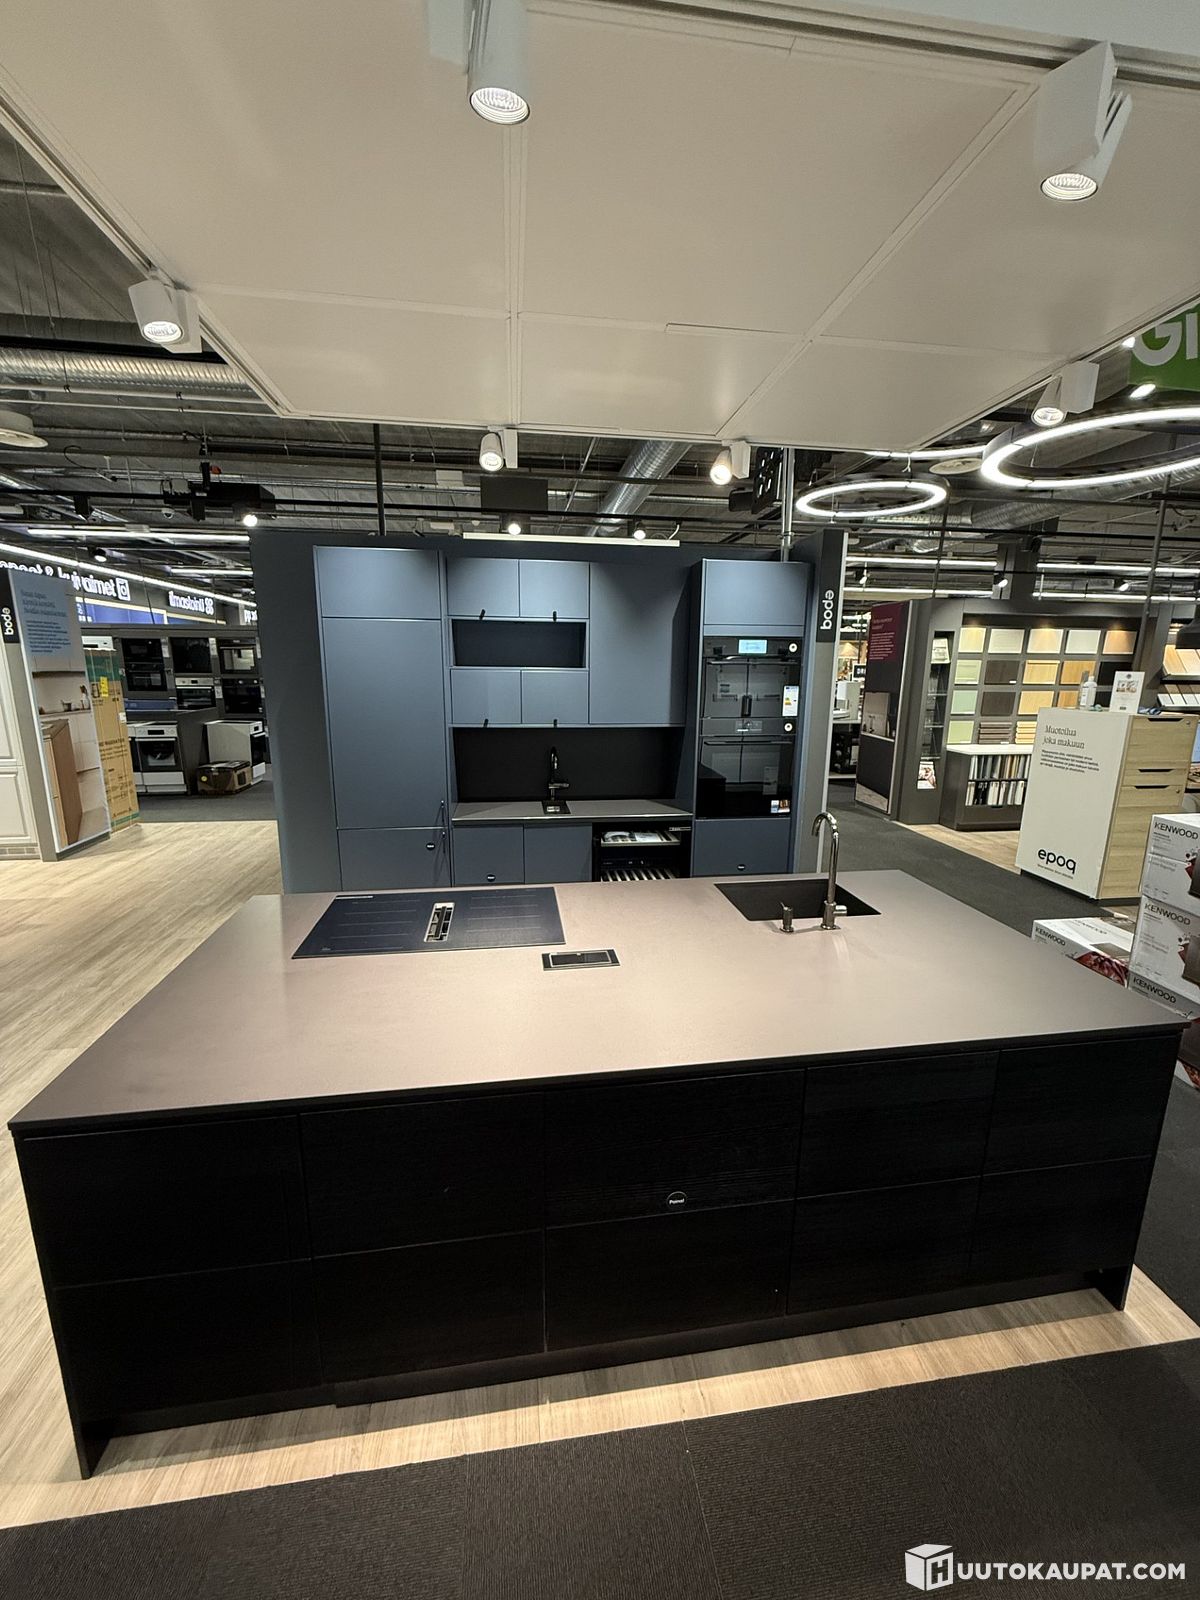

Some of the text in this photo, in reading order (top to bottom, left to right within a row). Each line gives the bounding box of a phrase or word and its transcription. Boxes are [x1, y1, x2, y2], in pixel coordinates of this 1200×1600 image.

[2, 607, 14, 635] epoq
[820, 590, 835, 630] epoq
[1154, 822, 1198, 840] KENWOOD
[1038, 849, 1076, 875] epoq
[1144, 903, 1191, 925] KENWOOD
[1035, 927, 1066, 946] KENWOOD
[1133, 976, 1177, 1003] KENWOOD
